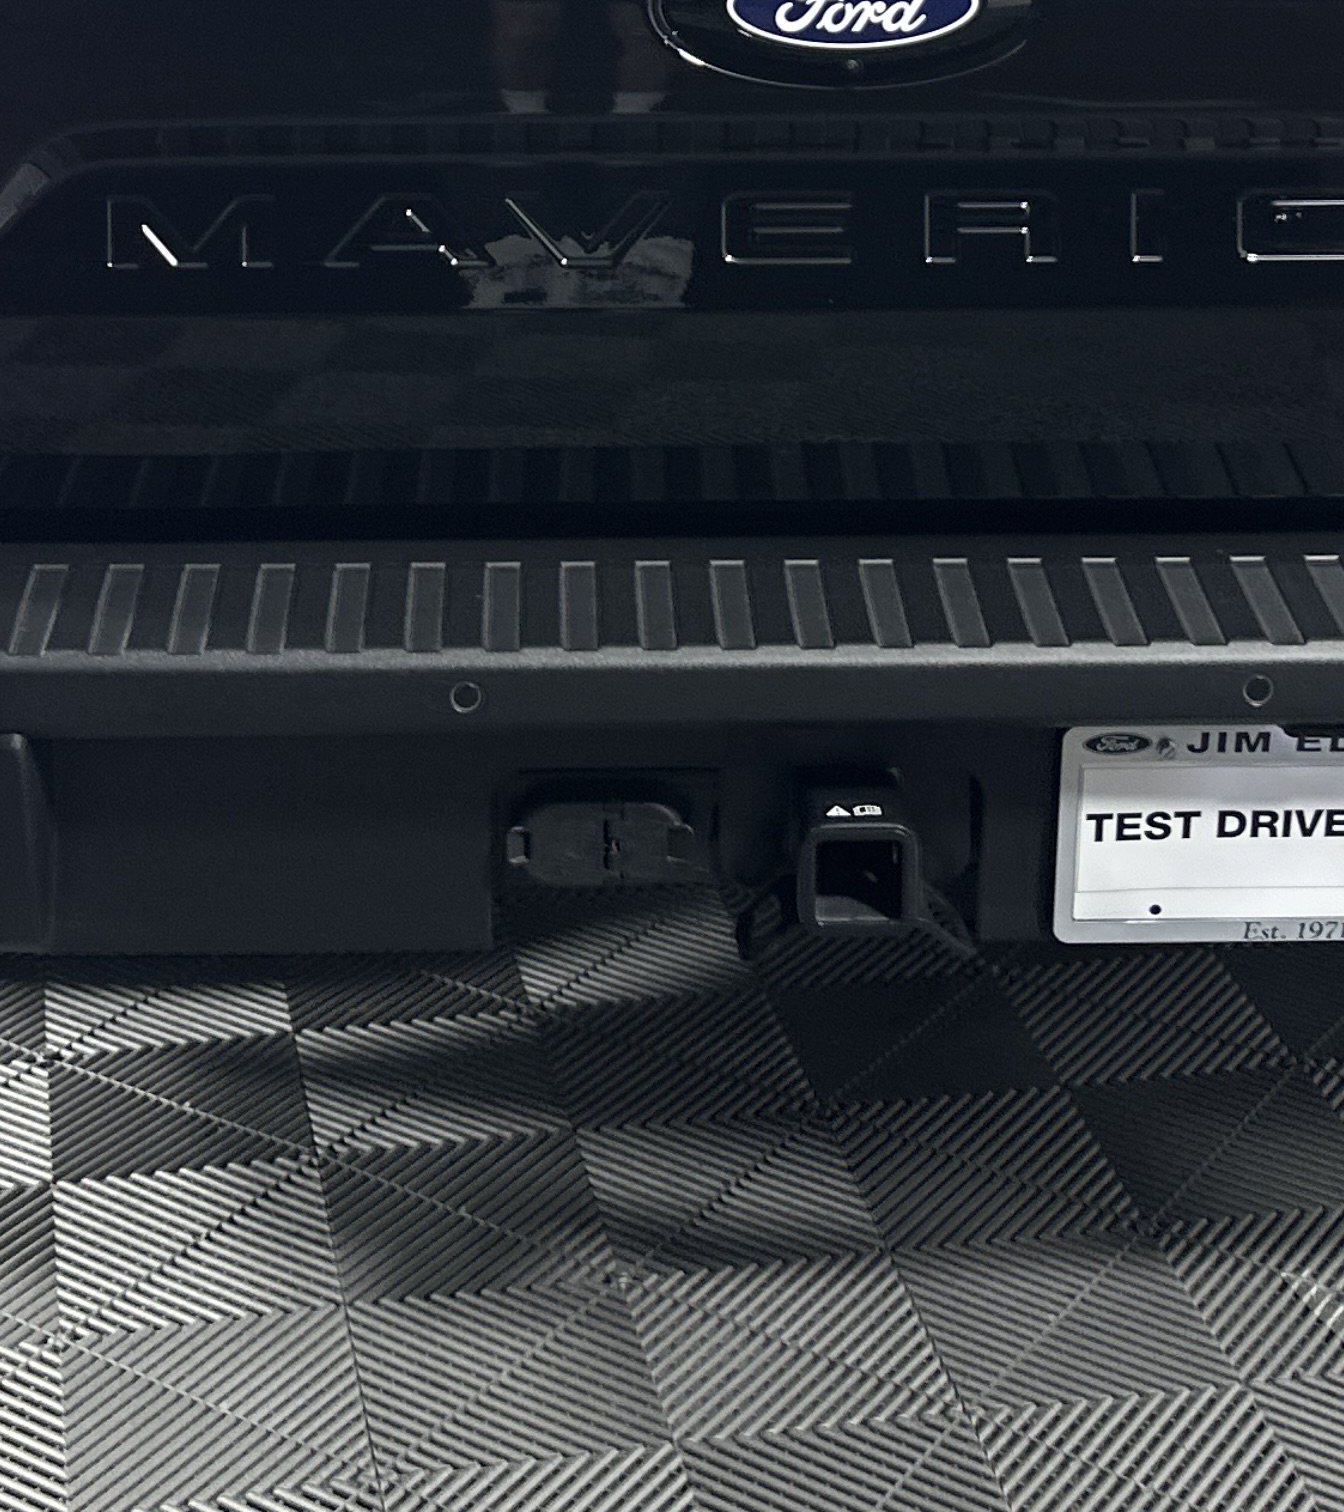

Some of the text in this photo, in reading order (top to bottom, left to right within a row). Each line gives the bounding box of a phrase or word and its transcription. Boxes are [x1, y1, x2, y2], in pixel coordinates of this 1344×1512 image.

[1094, 734, 1148, 753] Ford
[1187, 730, 1271, 754] JIM
[1086, 809, 1201, 842] TEST
[1242, 920, 1288, 941] Est.
